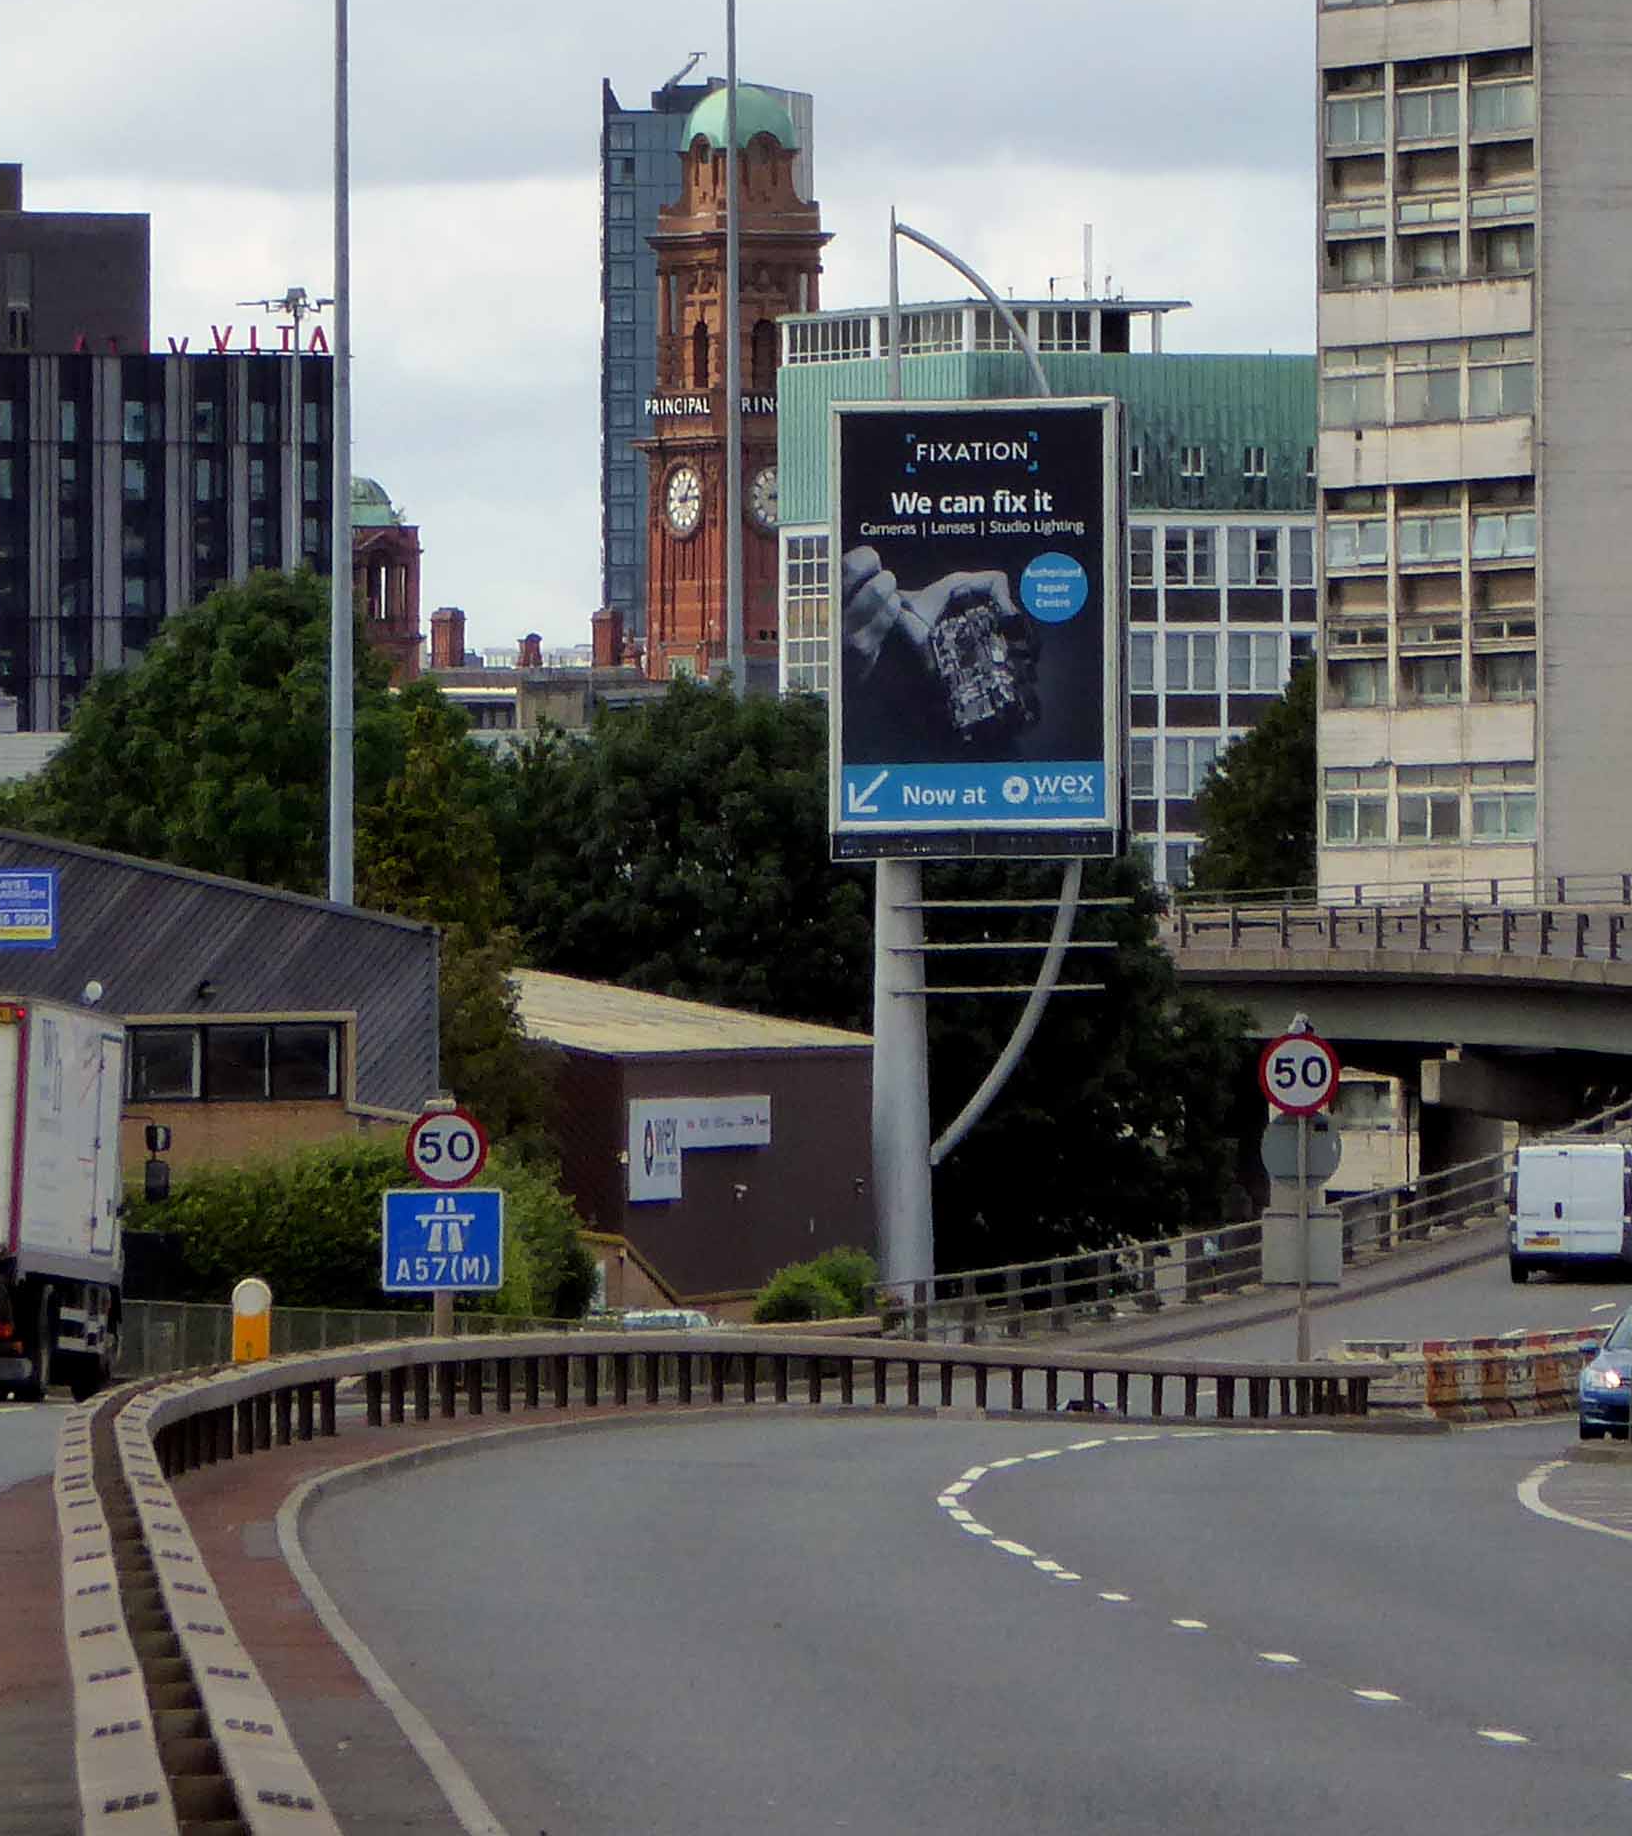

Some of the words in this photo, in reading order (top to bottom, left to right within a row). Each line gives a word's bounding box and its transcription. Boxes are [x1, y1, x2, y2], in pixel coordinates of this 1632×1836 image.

[211, 325, 329, 354] VITA
[644, 396, 711, 415] PRINCIPAL
[916, 442, 1028, 462] FIXATION
[891, 491, 933, 515] We
[939, 494, 985, 514] can
[993, 489, 1028, 513] fix
[1034, 489, 1053, 512] it
[860, 522, 917, 537] Cameras
[931, 521, 976, 534] Lenses
[989, 520, 1031, 534] Studio
[1034, 519, 1085, 536] Lighting
[903, 785, 956, 805] Now
[962, 786, 986, 805] at
[1033, 775, 1094, 795] wex
[1274, 1056, 1328, 1089] 50
[418, 1130, 475, 1165] 50
[395, 1254, 491, 1283] A57(M)
